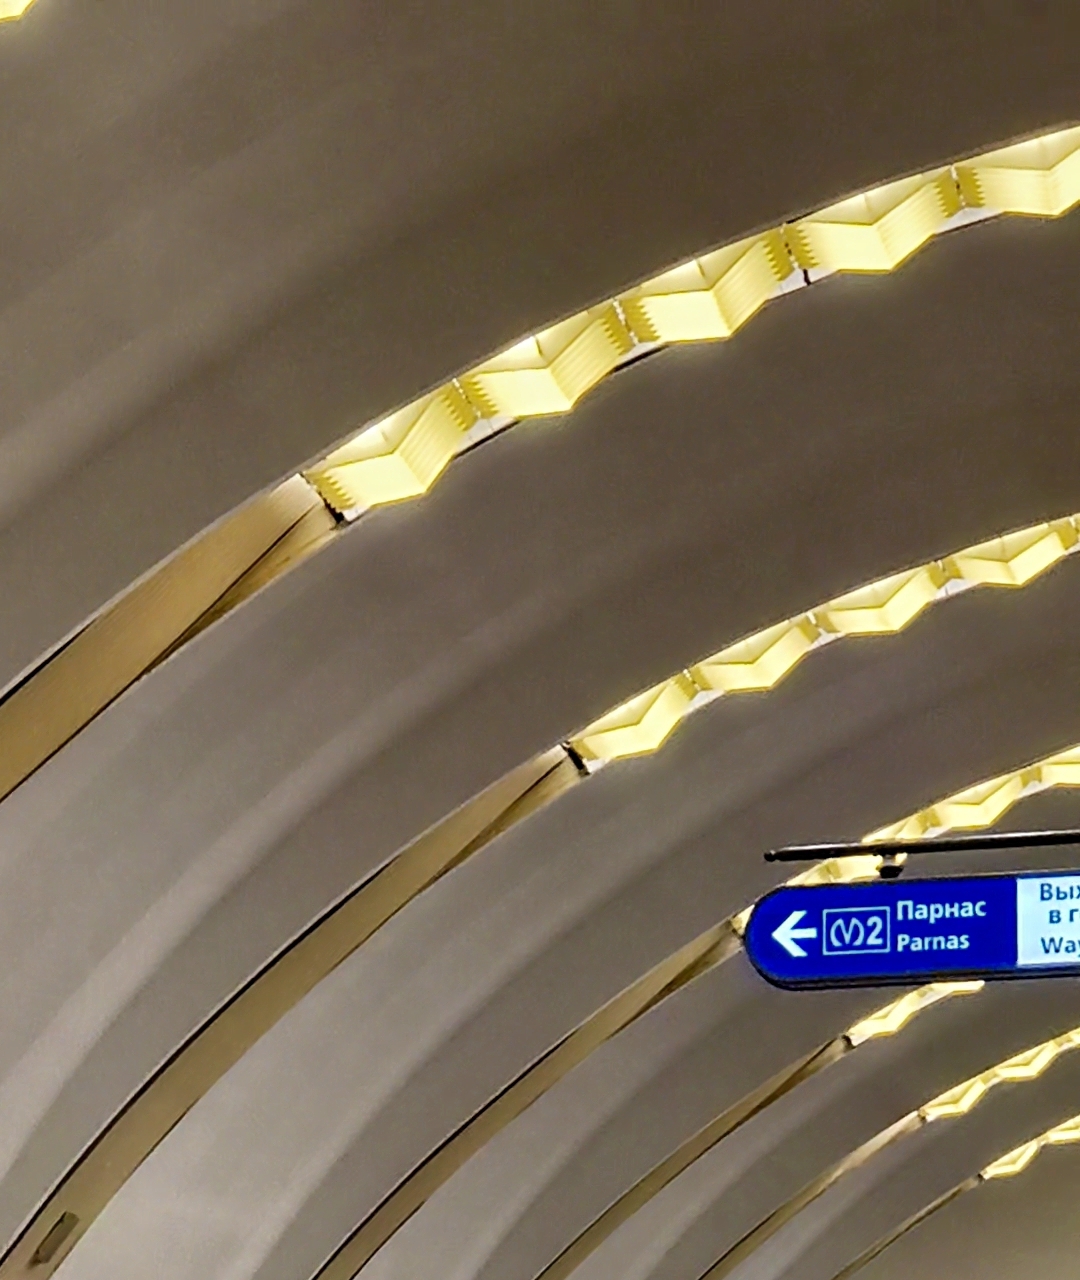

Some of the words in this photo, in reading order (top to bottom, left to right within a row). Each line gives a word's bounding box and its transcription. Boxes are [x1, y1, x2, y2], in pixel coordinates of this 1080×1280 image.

[896, 900, 987, 923] Парнас
[896, 933, 970, 952] Parnas
[1040, 936, 1080, 958] Wa
